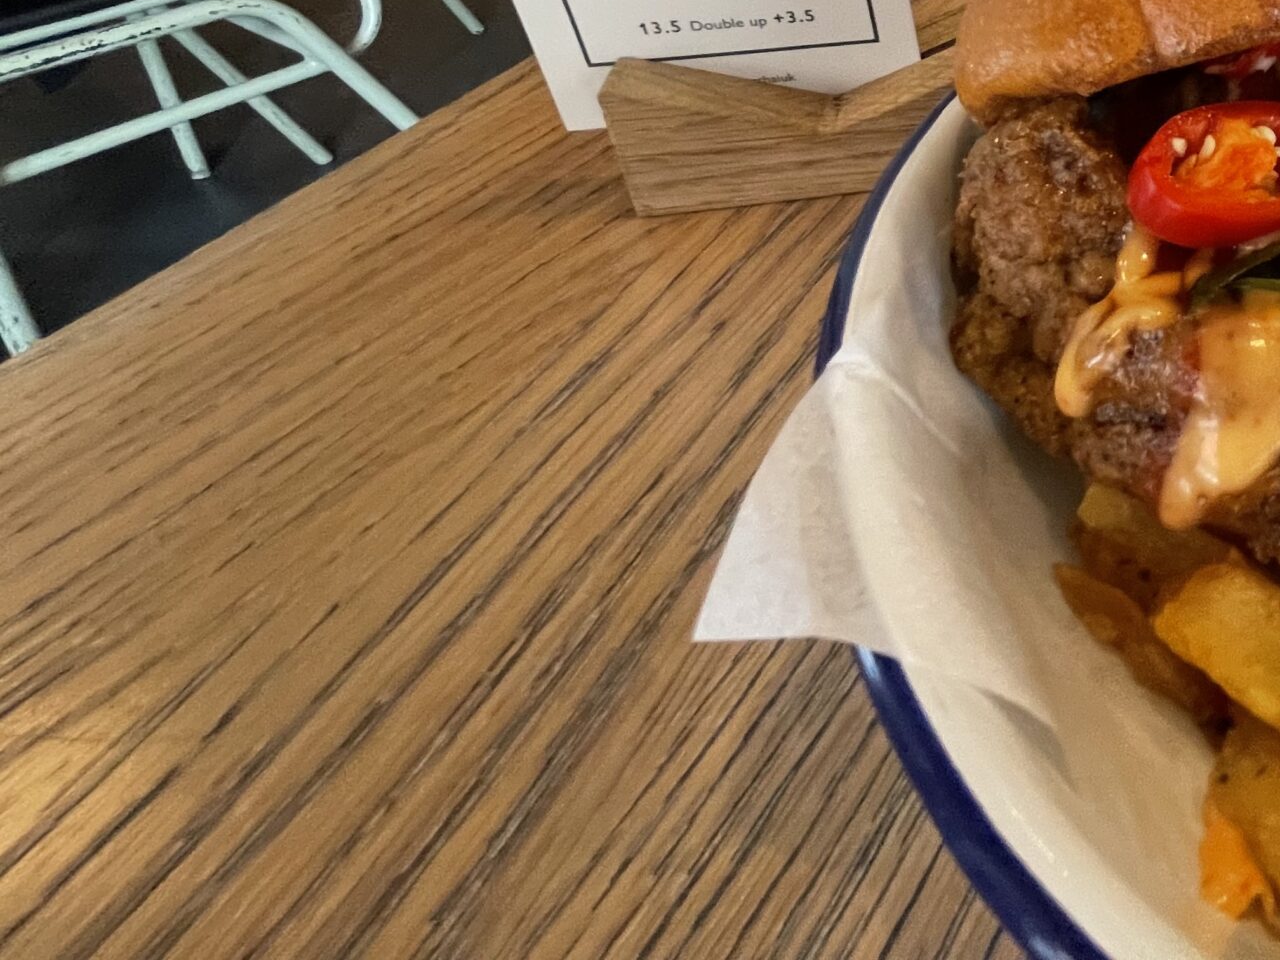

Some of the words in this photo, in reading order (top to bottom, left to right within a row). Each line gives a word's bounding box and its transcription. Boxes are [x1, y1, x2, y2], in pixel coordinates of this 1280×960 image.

[638, 19, 682, 36] 13.5
[689, 18, 745, 32] Double
[748, 18, 768, 30] up
[772, 8, 816, 24] +3.5
